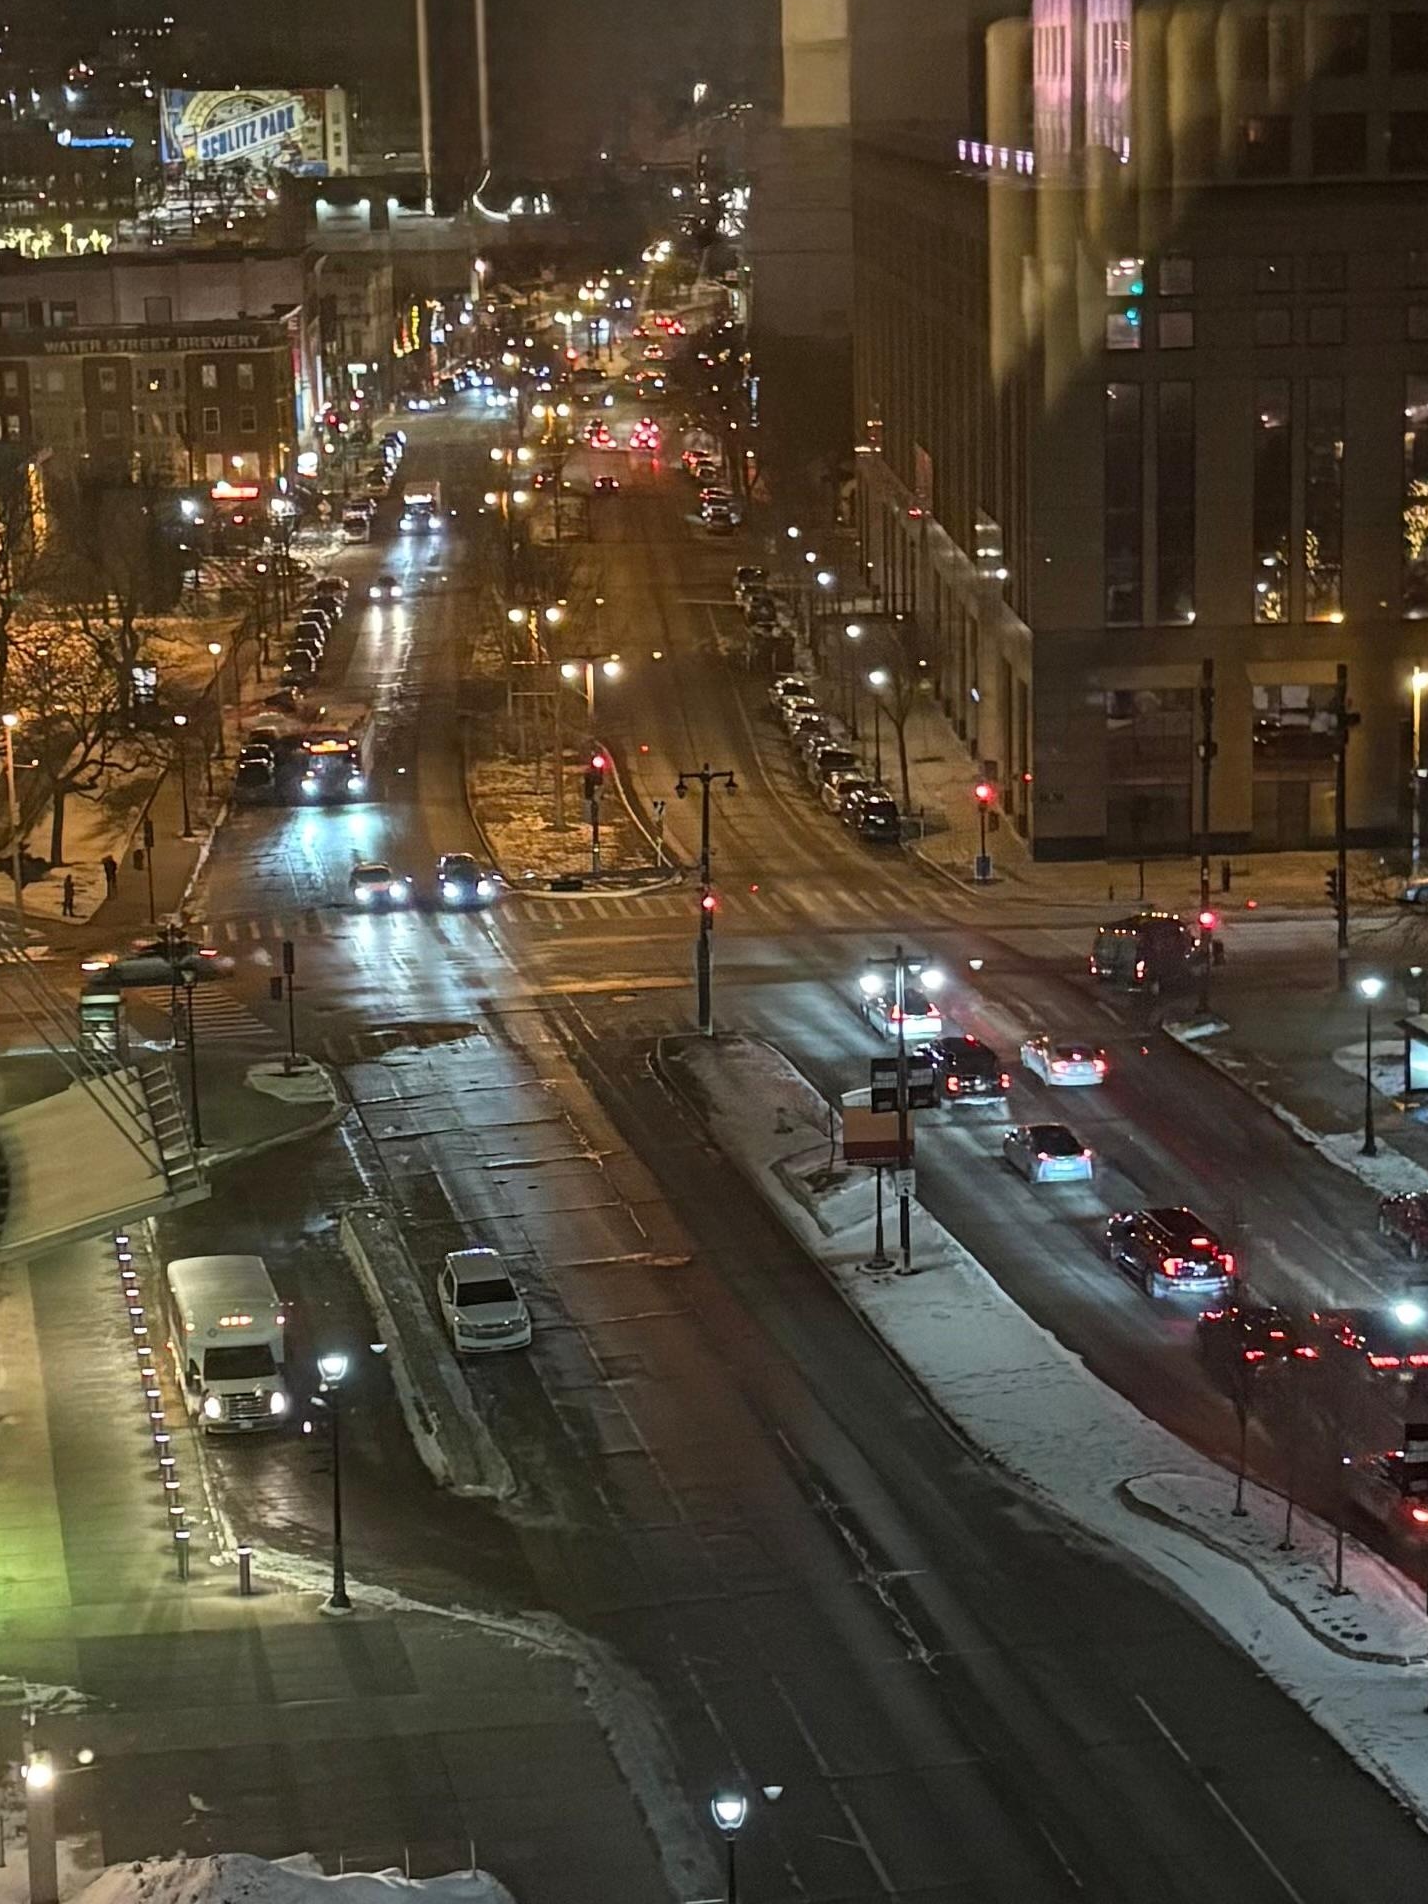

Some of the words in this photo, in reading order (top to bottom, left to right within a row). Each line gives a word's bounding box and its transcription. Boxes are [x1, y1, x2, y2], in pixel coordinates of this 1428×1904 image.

[259, 104, 296, 140] PARK
[44, 340, 102, 354] WATER
[106, 337, 171, 352] STREET
[177, 334, 261, 349] BREWERY
